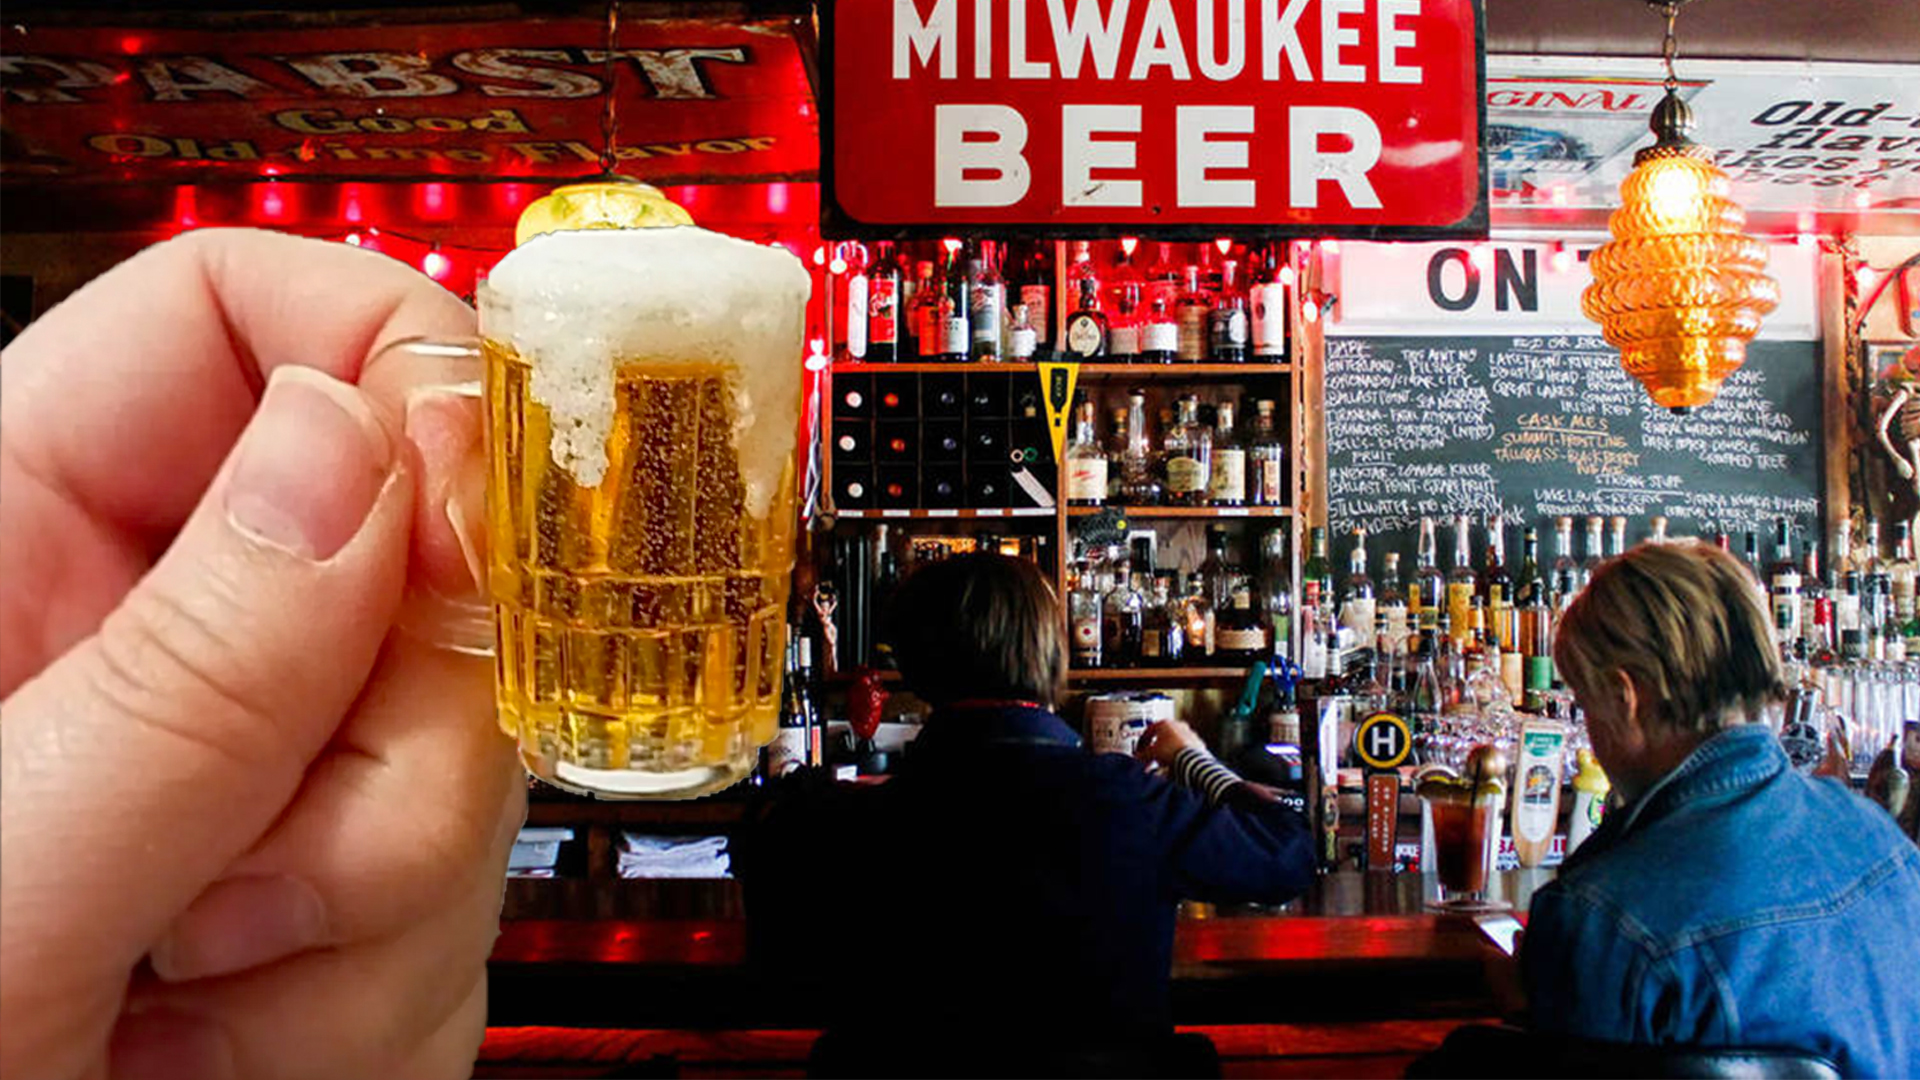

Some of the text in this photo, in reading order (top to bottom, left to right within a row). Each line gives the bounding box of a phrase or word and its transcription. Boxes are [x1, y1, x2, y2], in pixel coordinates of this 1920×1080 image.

[893, 0, 1422, 83] MILWAUKEE
[0, 48, 746, 102] PABST
[88, 132, 260, 160] Old
[508, 137, 777, 164] Flavor
[274, 109, 530, 134] Good
[935, 104, 1383, 208] BEER
[1427, 248, 1539, 312] ON
